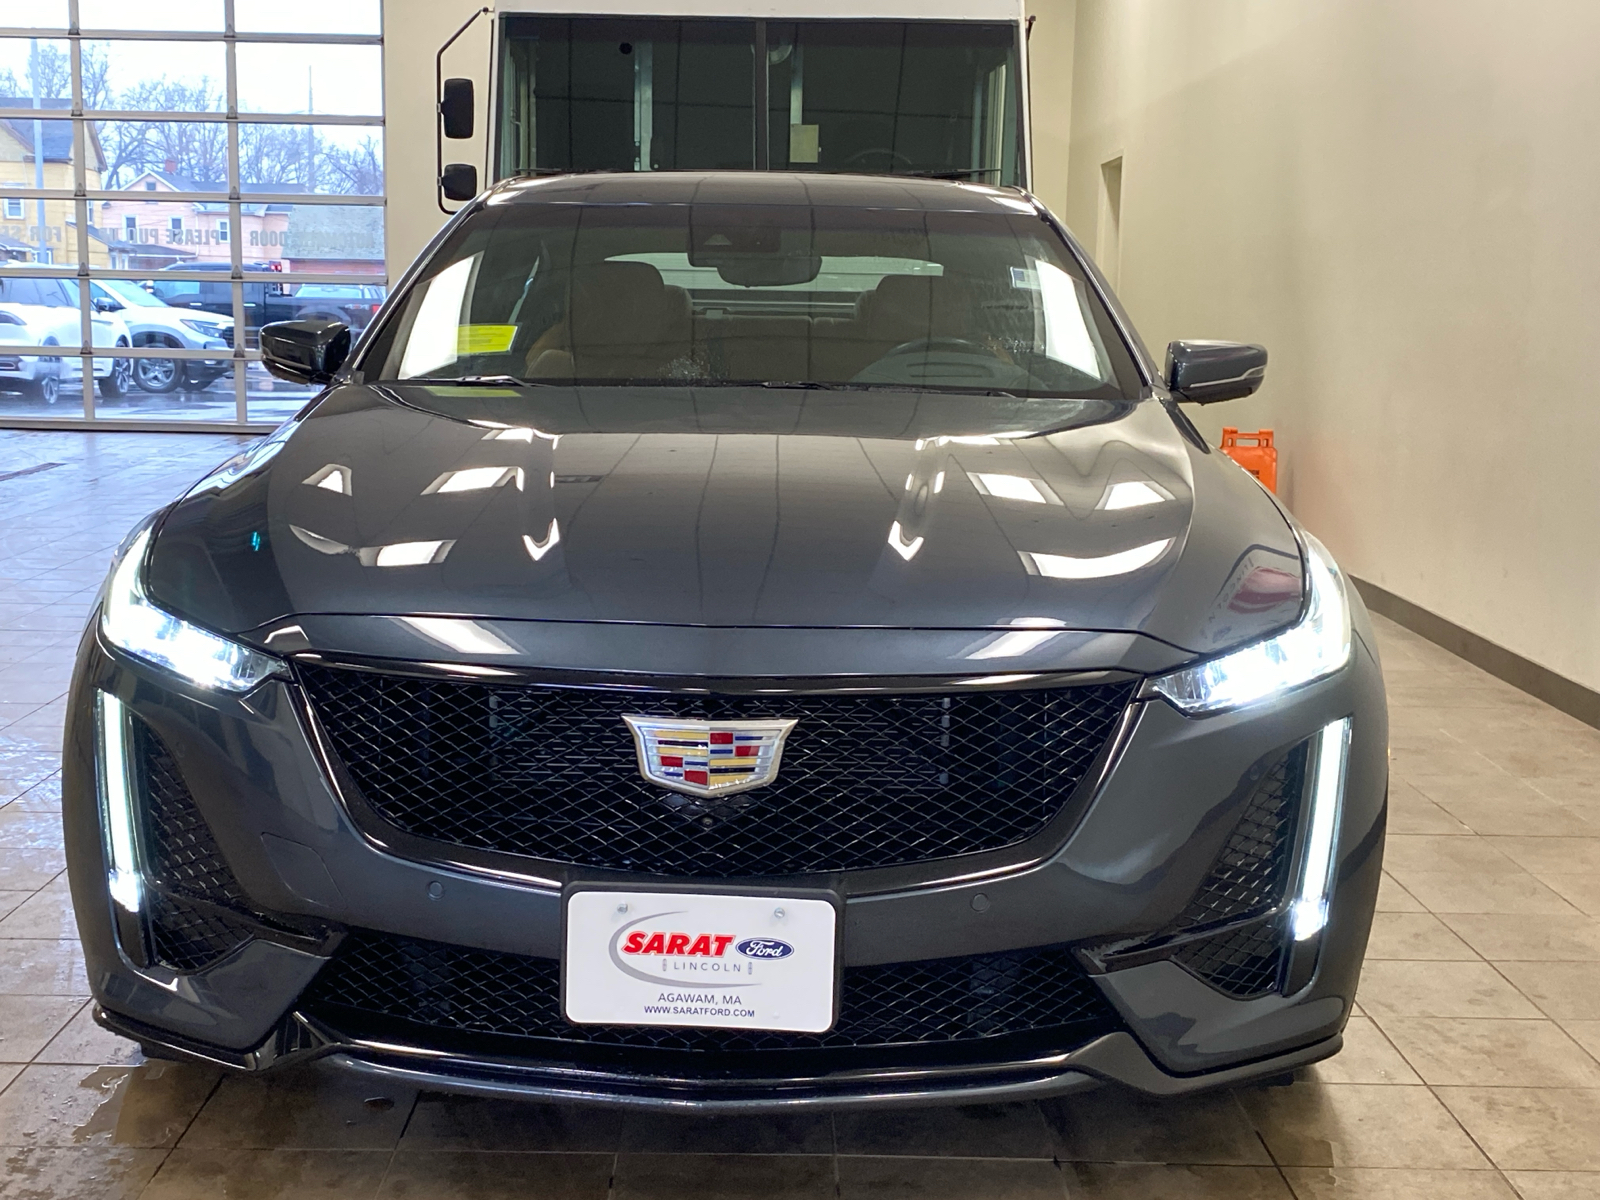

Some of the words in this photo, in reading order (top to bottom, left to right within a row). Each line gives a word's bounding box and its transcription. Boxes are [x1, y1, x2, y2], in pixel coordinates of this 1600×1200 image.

[621, 931, 736, 958] SARAT
[673, 961, 741, 972] LINCOLN
[657, 992, 718, 1005] AGAWAM,
[722, 994, 742, 1005] MA
[644, 1005, 755, 1017] WWW.SARATFORD.COM
